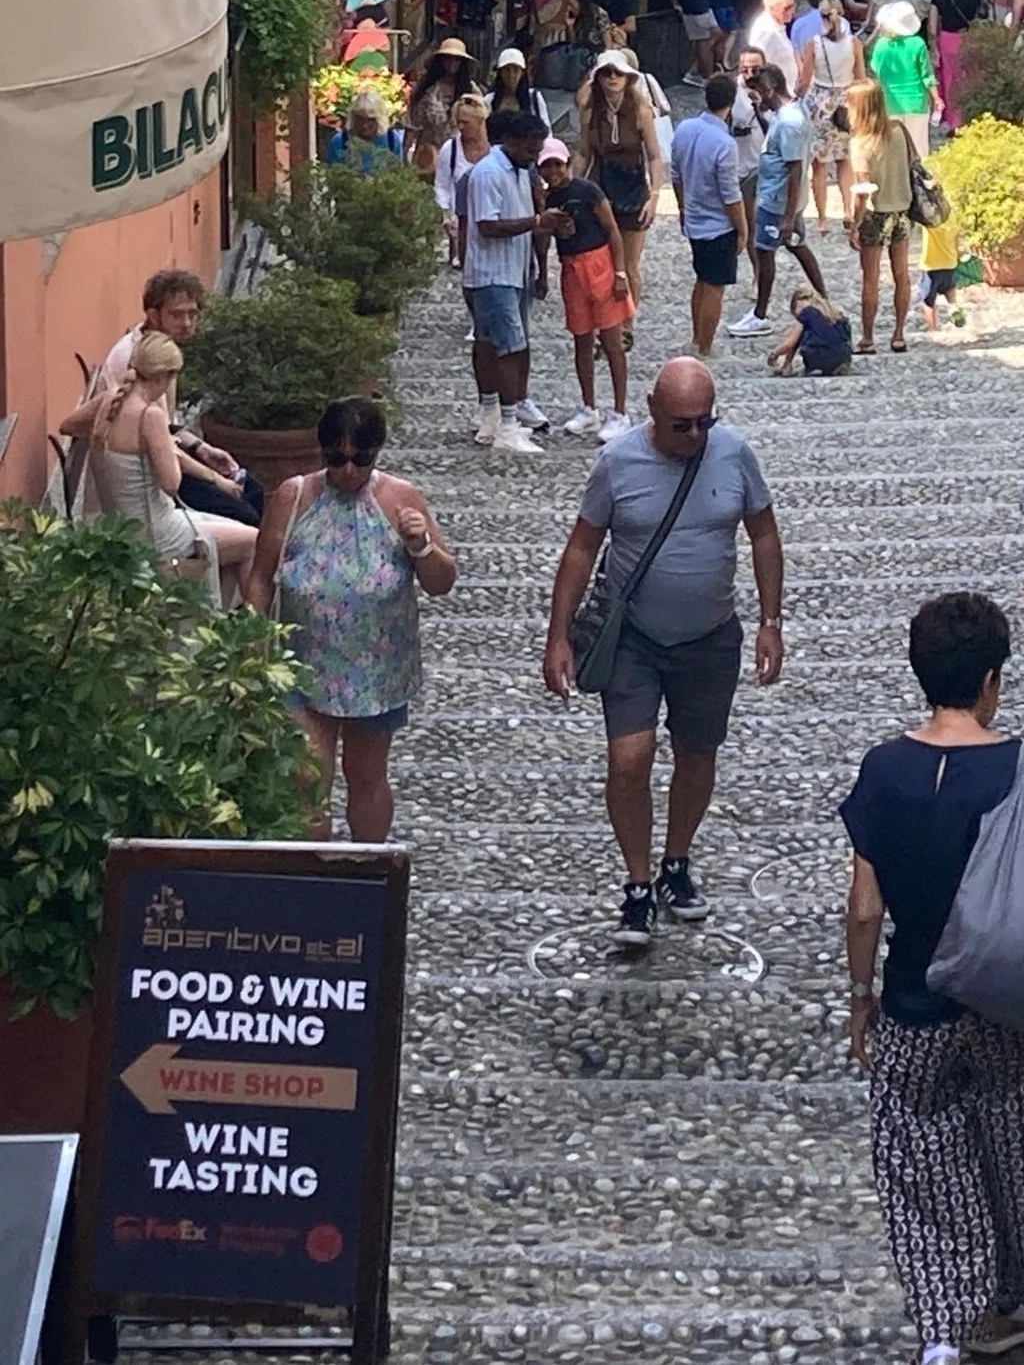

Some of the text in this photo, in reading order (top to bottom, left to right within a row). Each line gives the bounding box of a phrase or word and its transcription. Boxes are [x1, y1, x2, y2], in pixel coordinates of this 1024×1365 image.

[143, 926, 301, 952] aperitivo
[336, 933, 363, 957] al
[131, 969, 366, 1011] FOOD & WINE
[167, 1010, 325, 1046] PAIRING
[159, 1068, 324, 1099] WINE SHOP
[184, 1122, 289, 1158] WINE
[149, 1159, 318, 1197] TASTING
